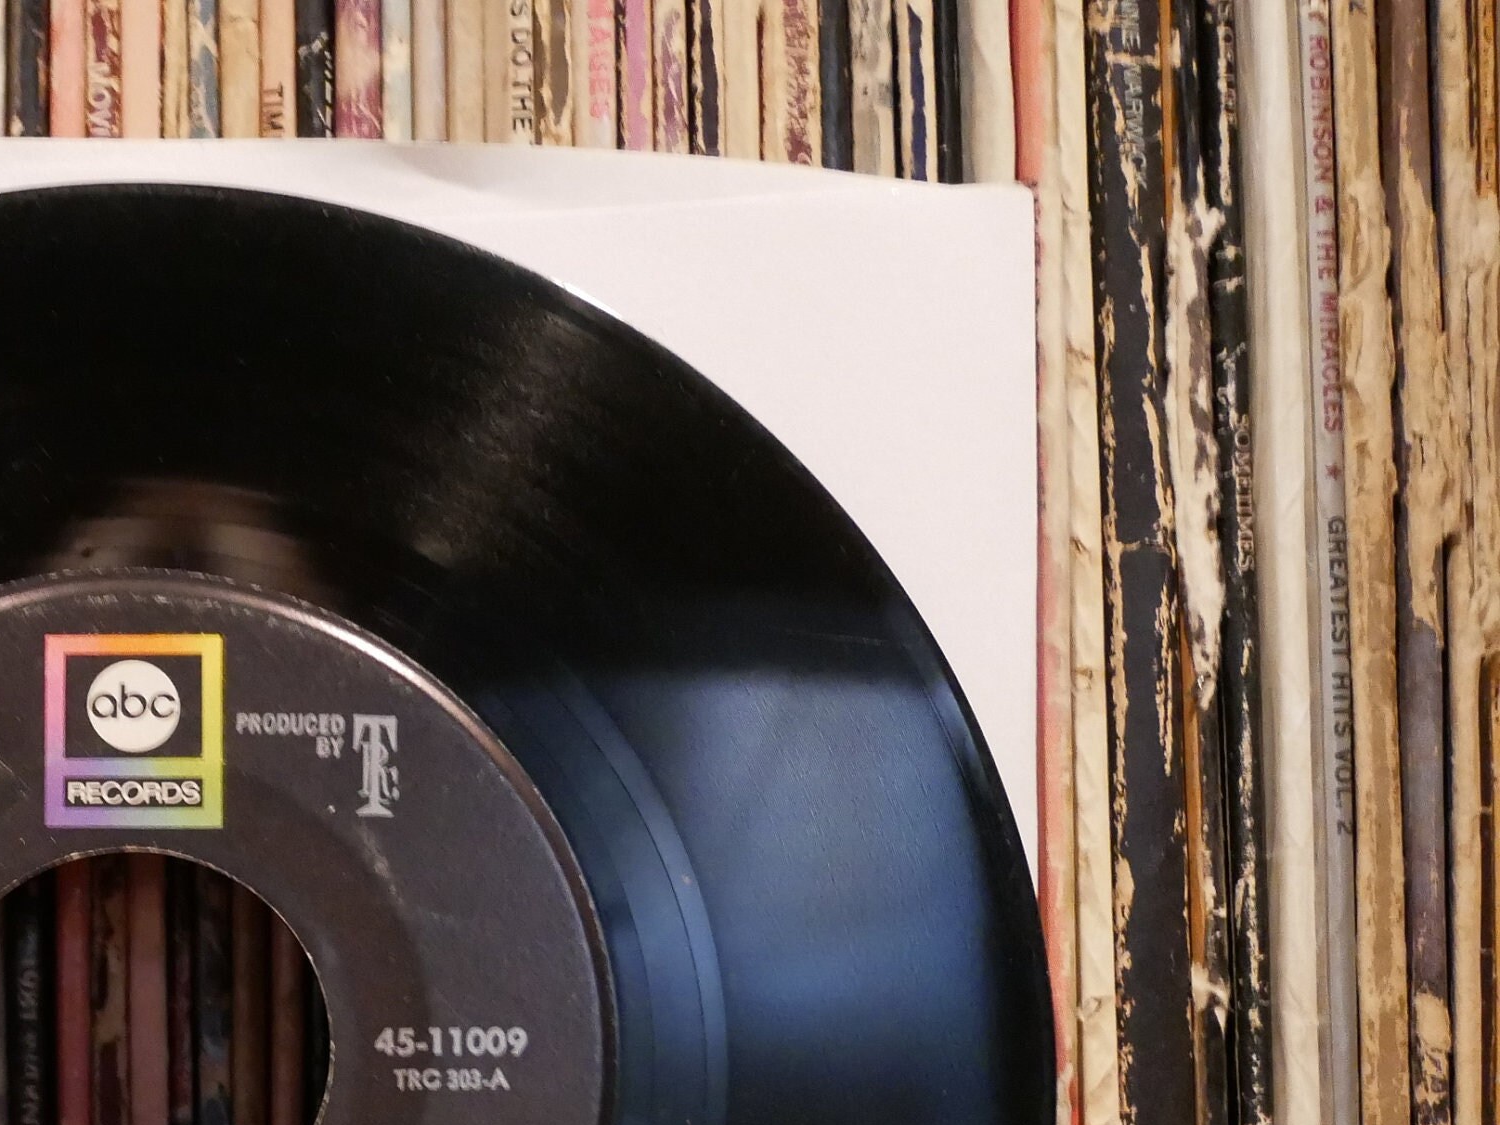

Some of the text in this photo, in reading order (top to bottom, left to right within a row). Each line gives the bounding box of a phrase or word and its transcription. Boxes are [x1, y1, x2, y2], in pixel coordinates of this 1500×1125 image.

[1310, 33, 1335, 184] ROBINSON
[1316, 227, 1339, 281] THE
[1318, 291, 1344, 434] MIRACLES
[1233, 414, 1255, 572] SOMETIMES
[1327, 515, 1354, 836] GREATEST HITS VOL. 2
[91, 683, 176, 719] abc
[236, 712, 346, 736] PRODUCED
[315, 736, 345, 758] BY
[66, 780, 201, 805] RECORDS
[373, 1025, 529, 1058] 45-11009
[393, 1066, 512, 1092] TRC 303-A
